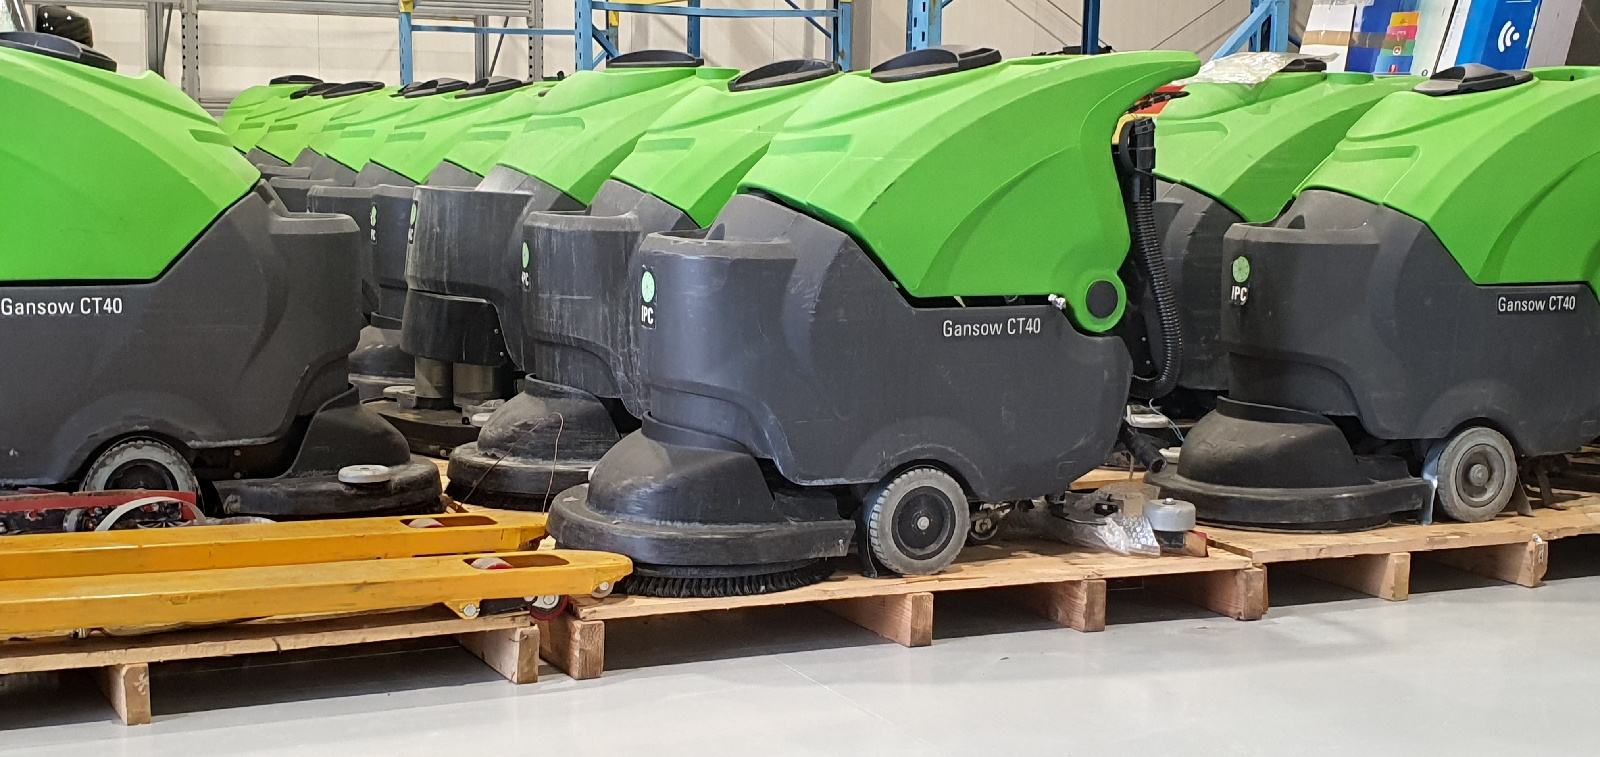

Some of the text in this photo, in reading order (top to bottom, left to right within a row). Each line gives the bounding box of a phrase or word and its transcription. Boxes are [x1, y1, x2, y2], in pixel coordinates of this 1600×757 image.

[1231, 285, 1248, 302] IPC
[1, 297, 122, 315] Gansow CT40
[1498, 295, 1576, 312] Gansow CT40
[641, 304, 654, 325] IPC
[943, 317, 1041, 337] Gansow CT40
